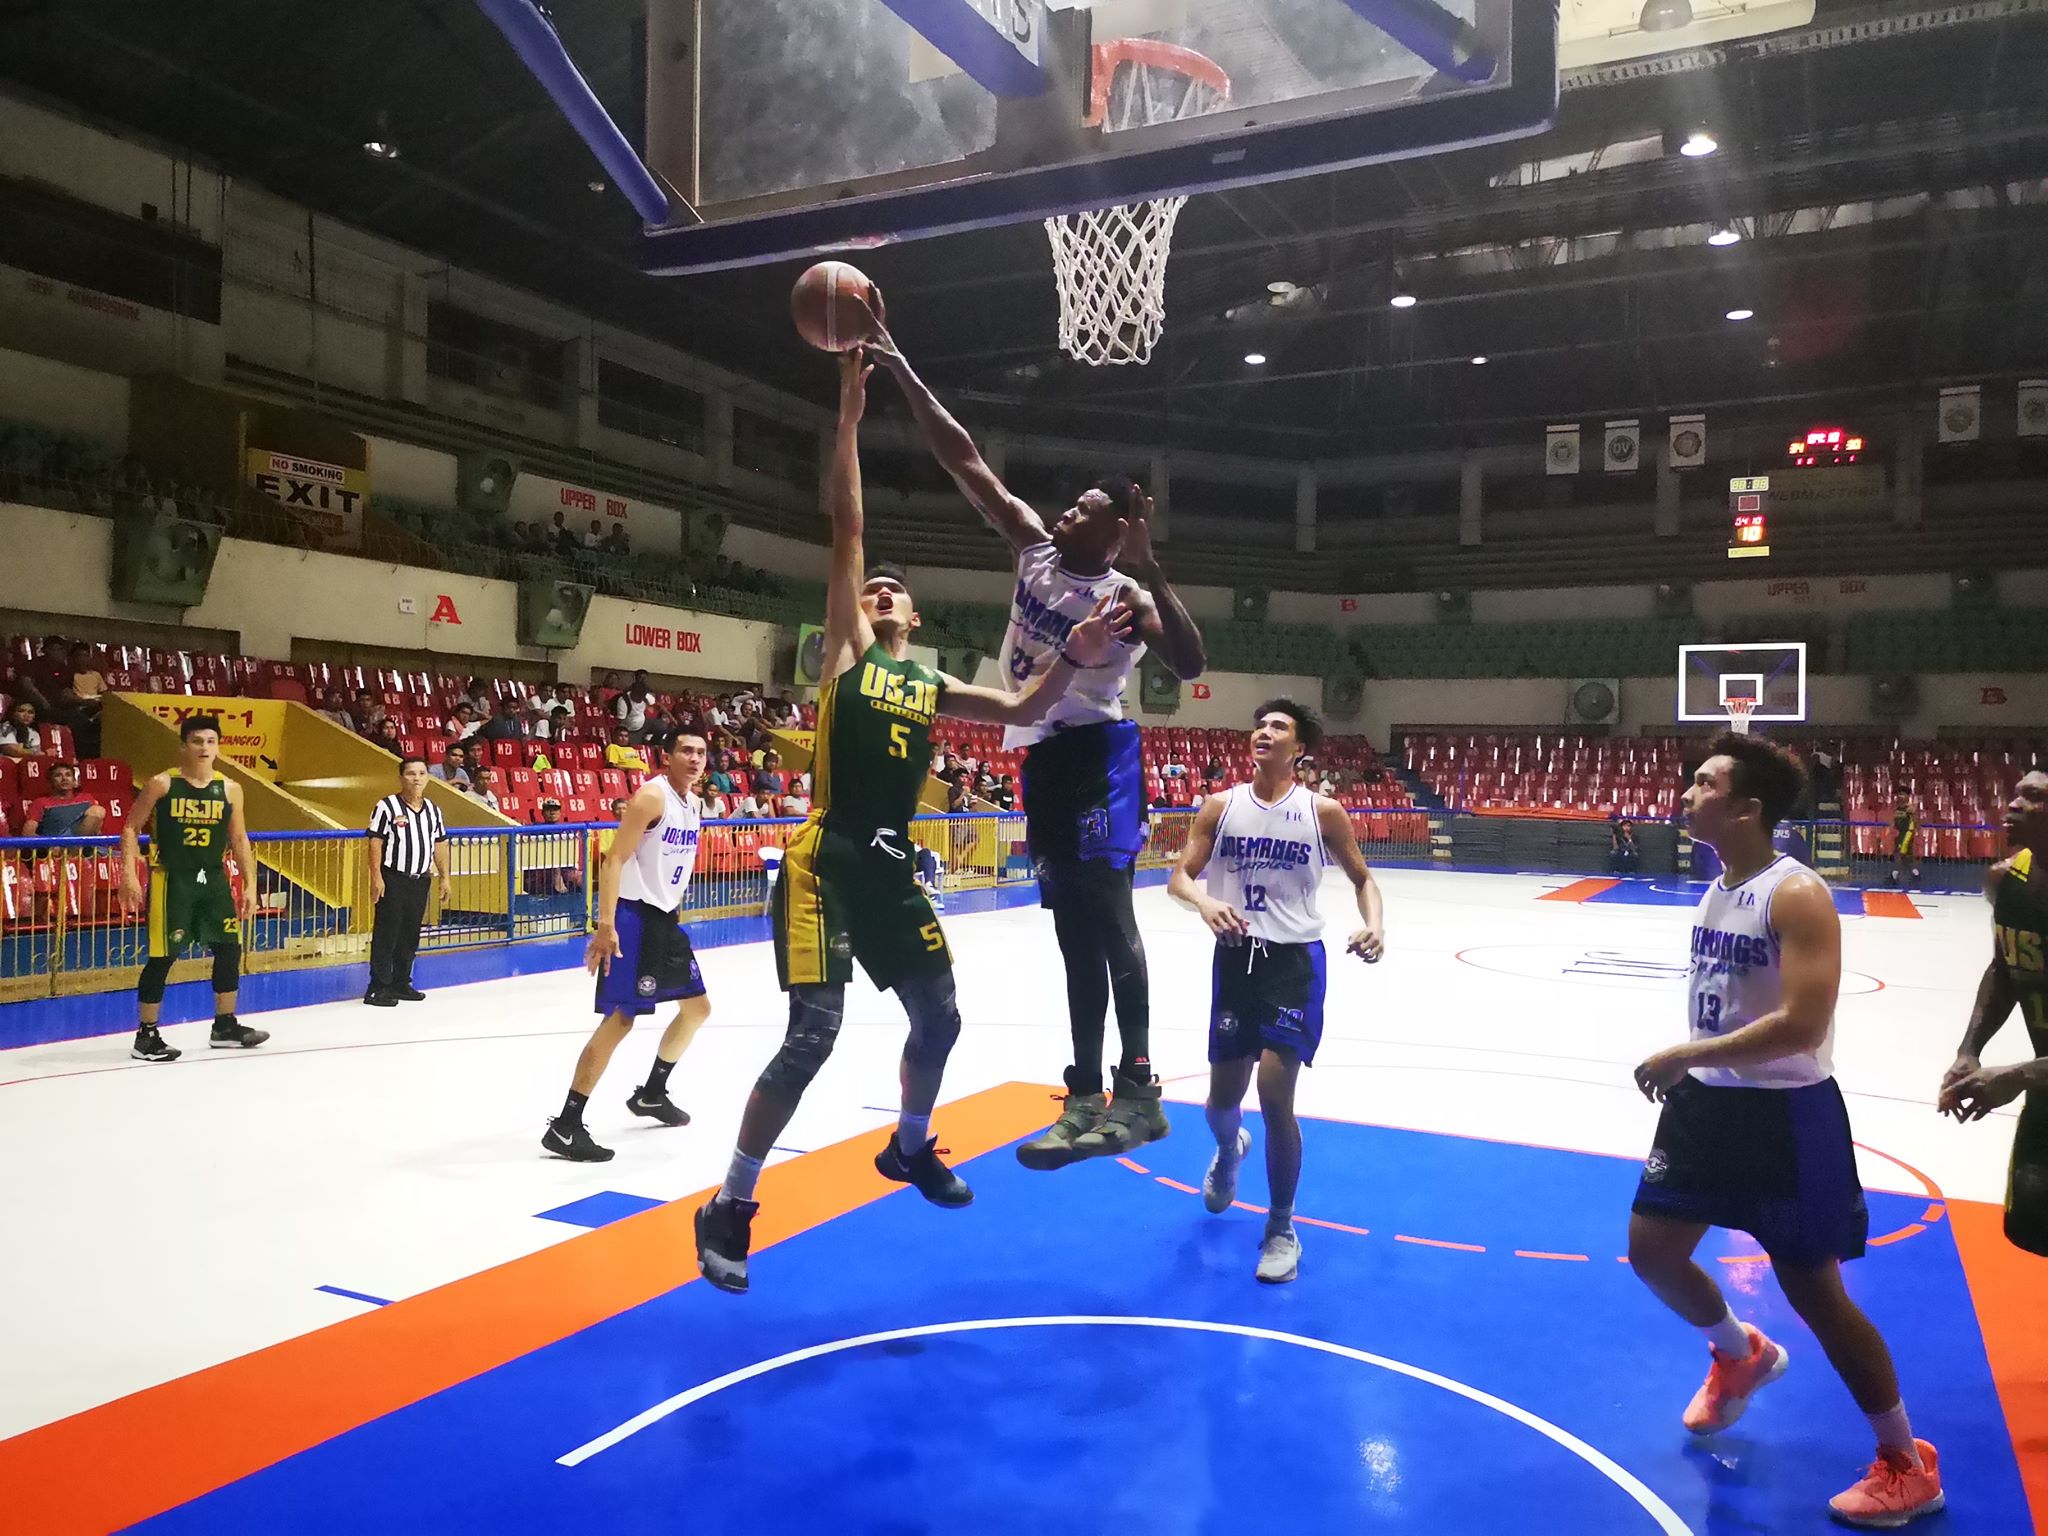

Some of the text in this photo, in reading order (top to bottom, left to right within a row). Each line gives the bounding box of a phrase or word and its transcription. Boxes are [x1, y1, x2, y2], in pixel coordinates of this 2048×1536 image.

[272, 457, 343, 481] NO SMOKING
[256, 473, 360, 513] EXIT
[561, 487, 628, 519] UPPER BOX
[429, 595, 463, 624] A
[625, 623, 702, 654] LOWER BOX
[860, 662, 938, 716] USJR
[888, 723, 911, 759] 5
[170, 797, 225, 820] USJR
[183, 827, 211, 847] 23
[671, 866, 684, 885] 9
[1245, 884, 1268, 912] 12
[223, 917, 241, 933] 23
[919, 921, 945, 951] 5
[1697, 992, 1721, 1032] 13
